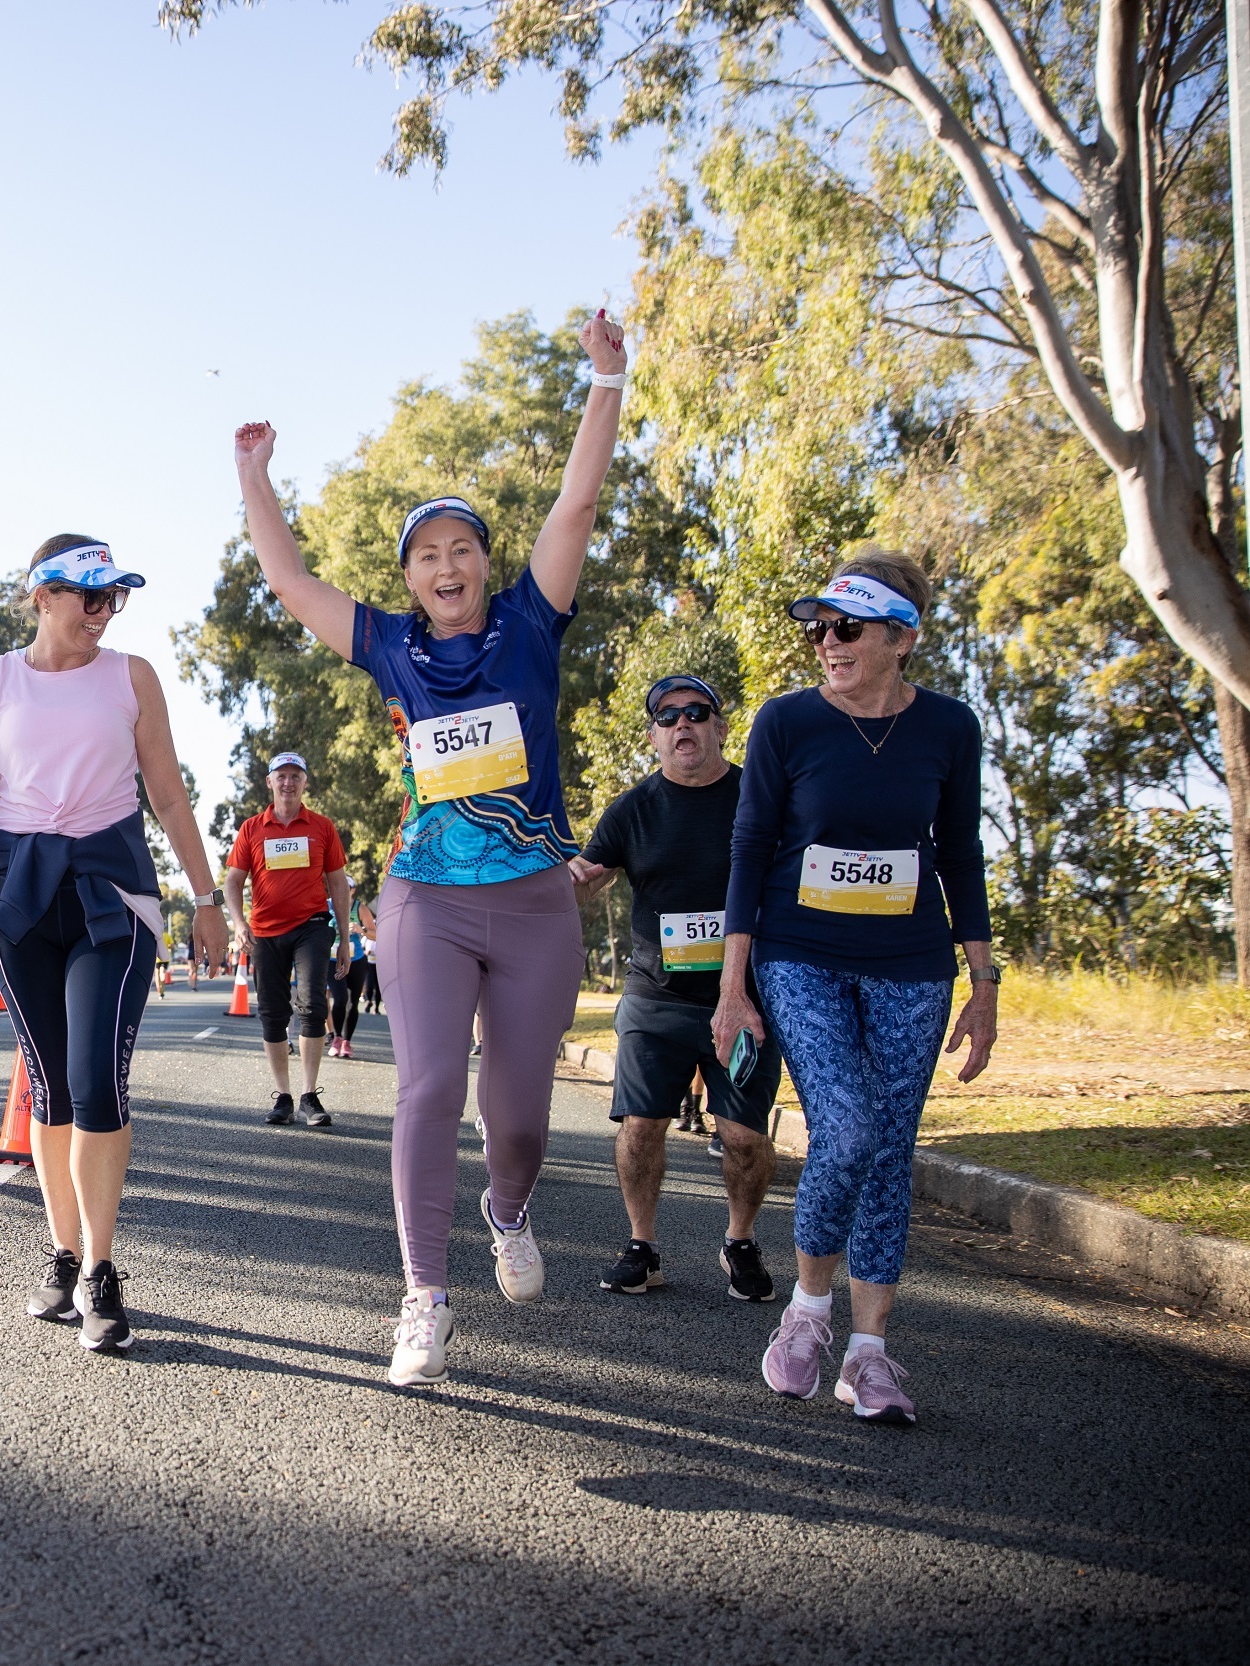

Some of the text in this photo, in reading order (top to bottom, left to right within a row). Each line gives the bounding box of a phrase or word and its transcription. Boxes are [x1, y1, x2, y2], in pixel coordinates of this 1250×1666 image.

[433, 721, 492, 754] 5547
[275, 842, 299, 853] 5673
[830, 861, 893, 884] 5548
[686, 921, 721, 939] 512
[19, 1034, 45, 1112] ROCKWEAR
